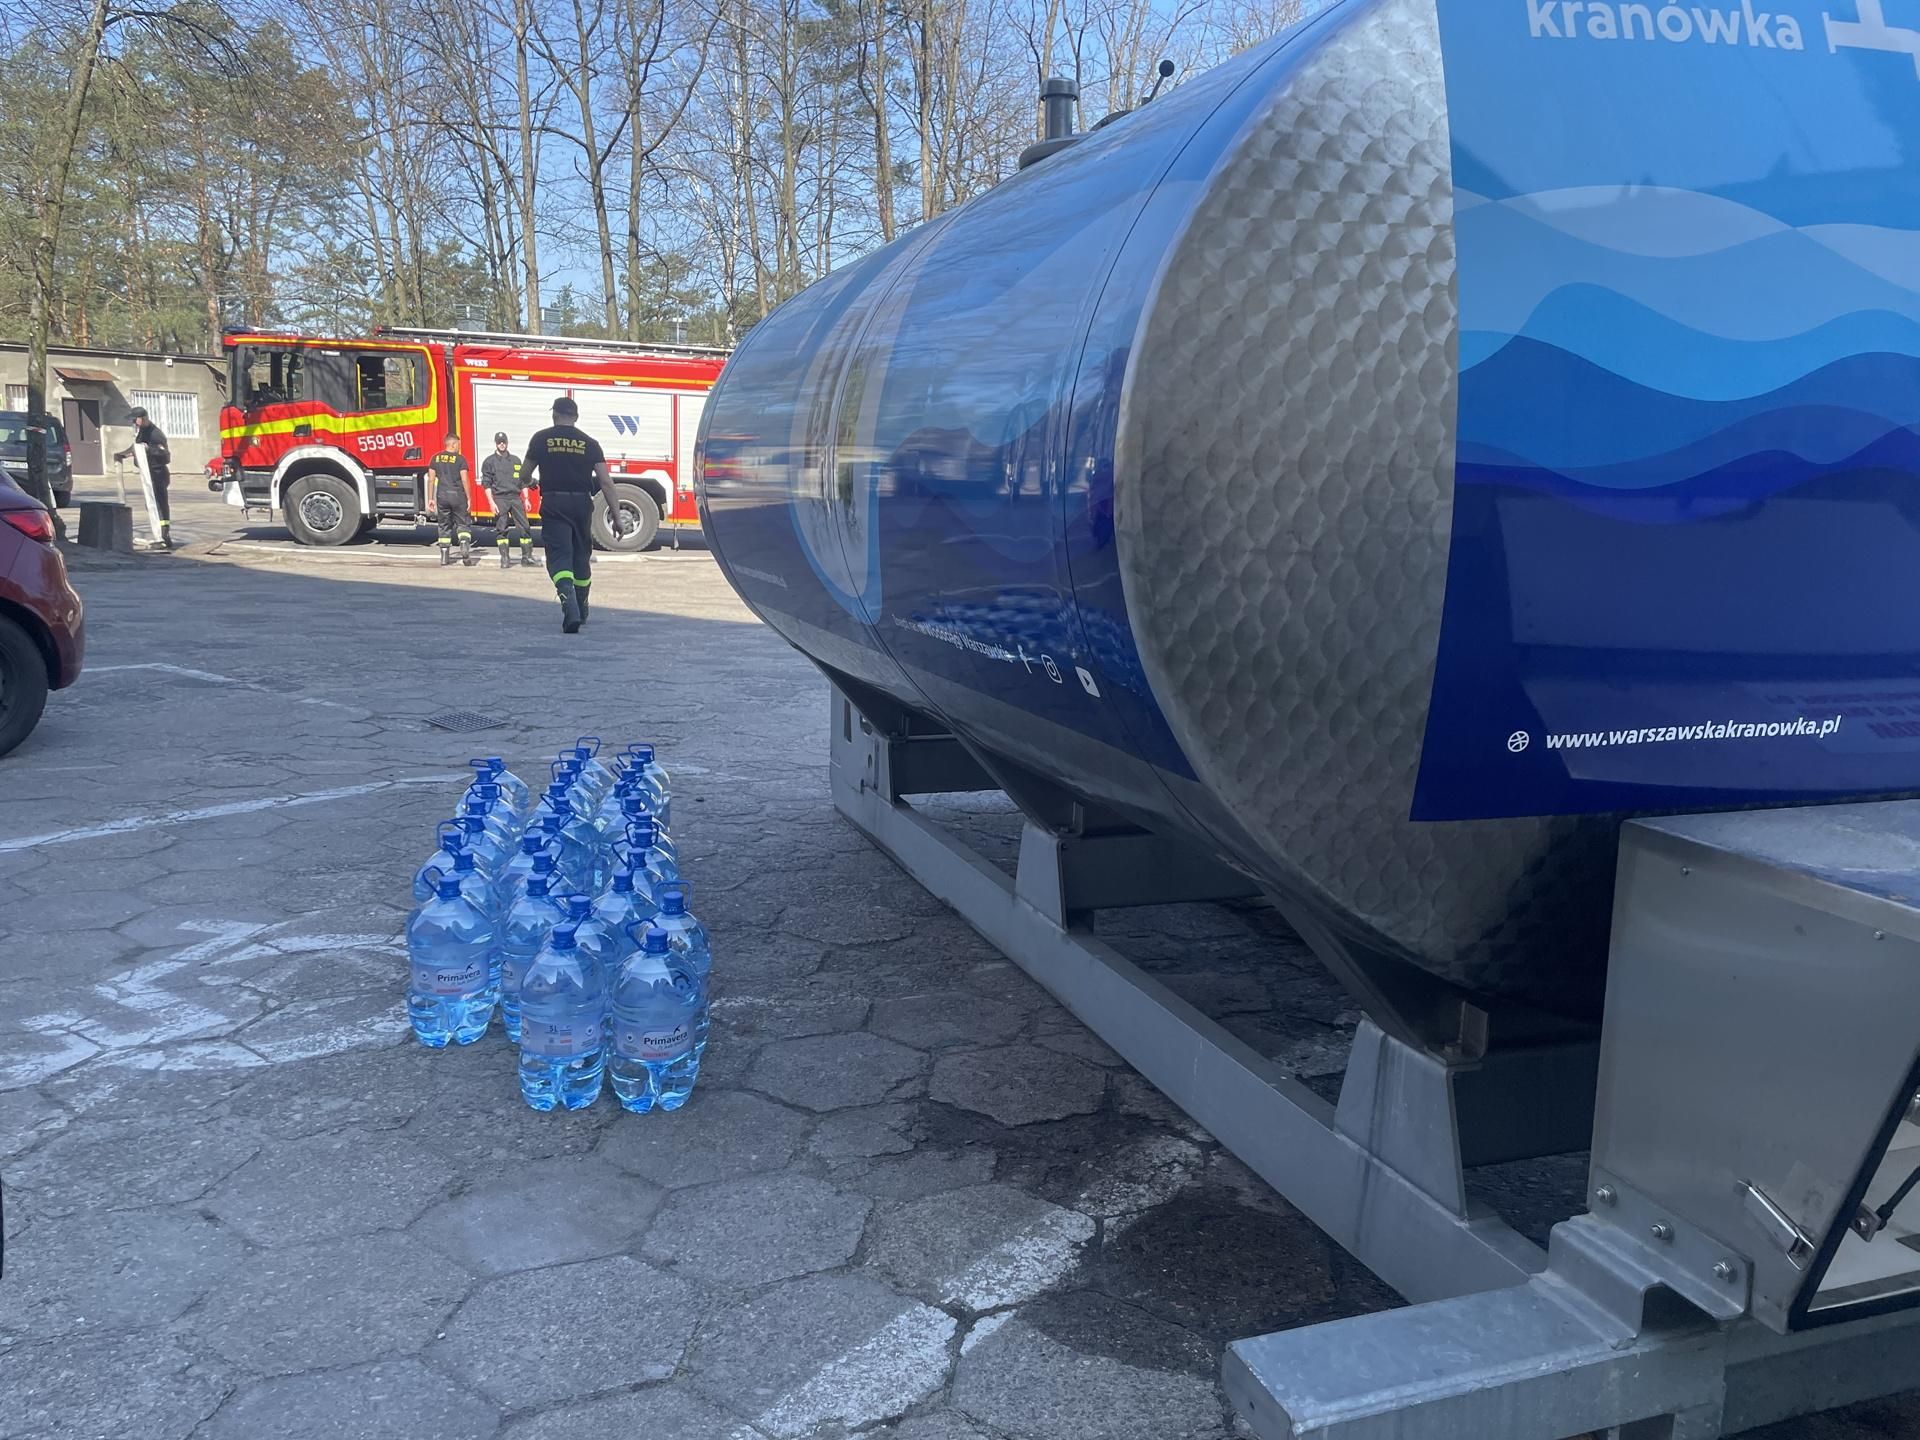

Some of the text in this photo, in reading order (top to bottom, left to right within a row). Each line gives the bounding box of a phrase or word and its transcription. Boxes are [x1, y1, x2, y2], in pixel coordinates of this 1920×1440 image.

[1526, 0, 1804, 51] kranówka
[357, 434, 386, 452] 559
[394, 431, 414, 449] 90
[1545, 714, 1841, 749] www.warszawskakranowka.pl
[437, 969, 481, 982] Primavera
[643, 1031, 689, 1046] Primavera
